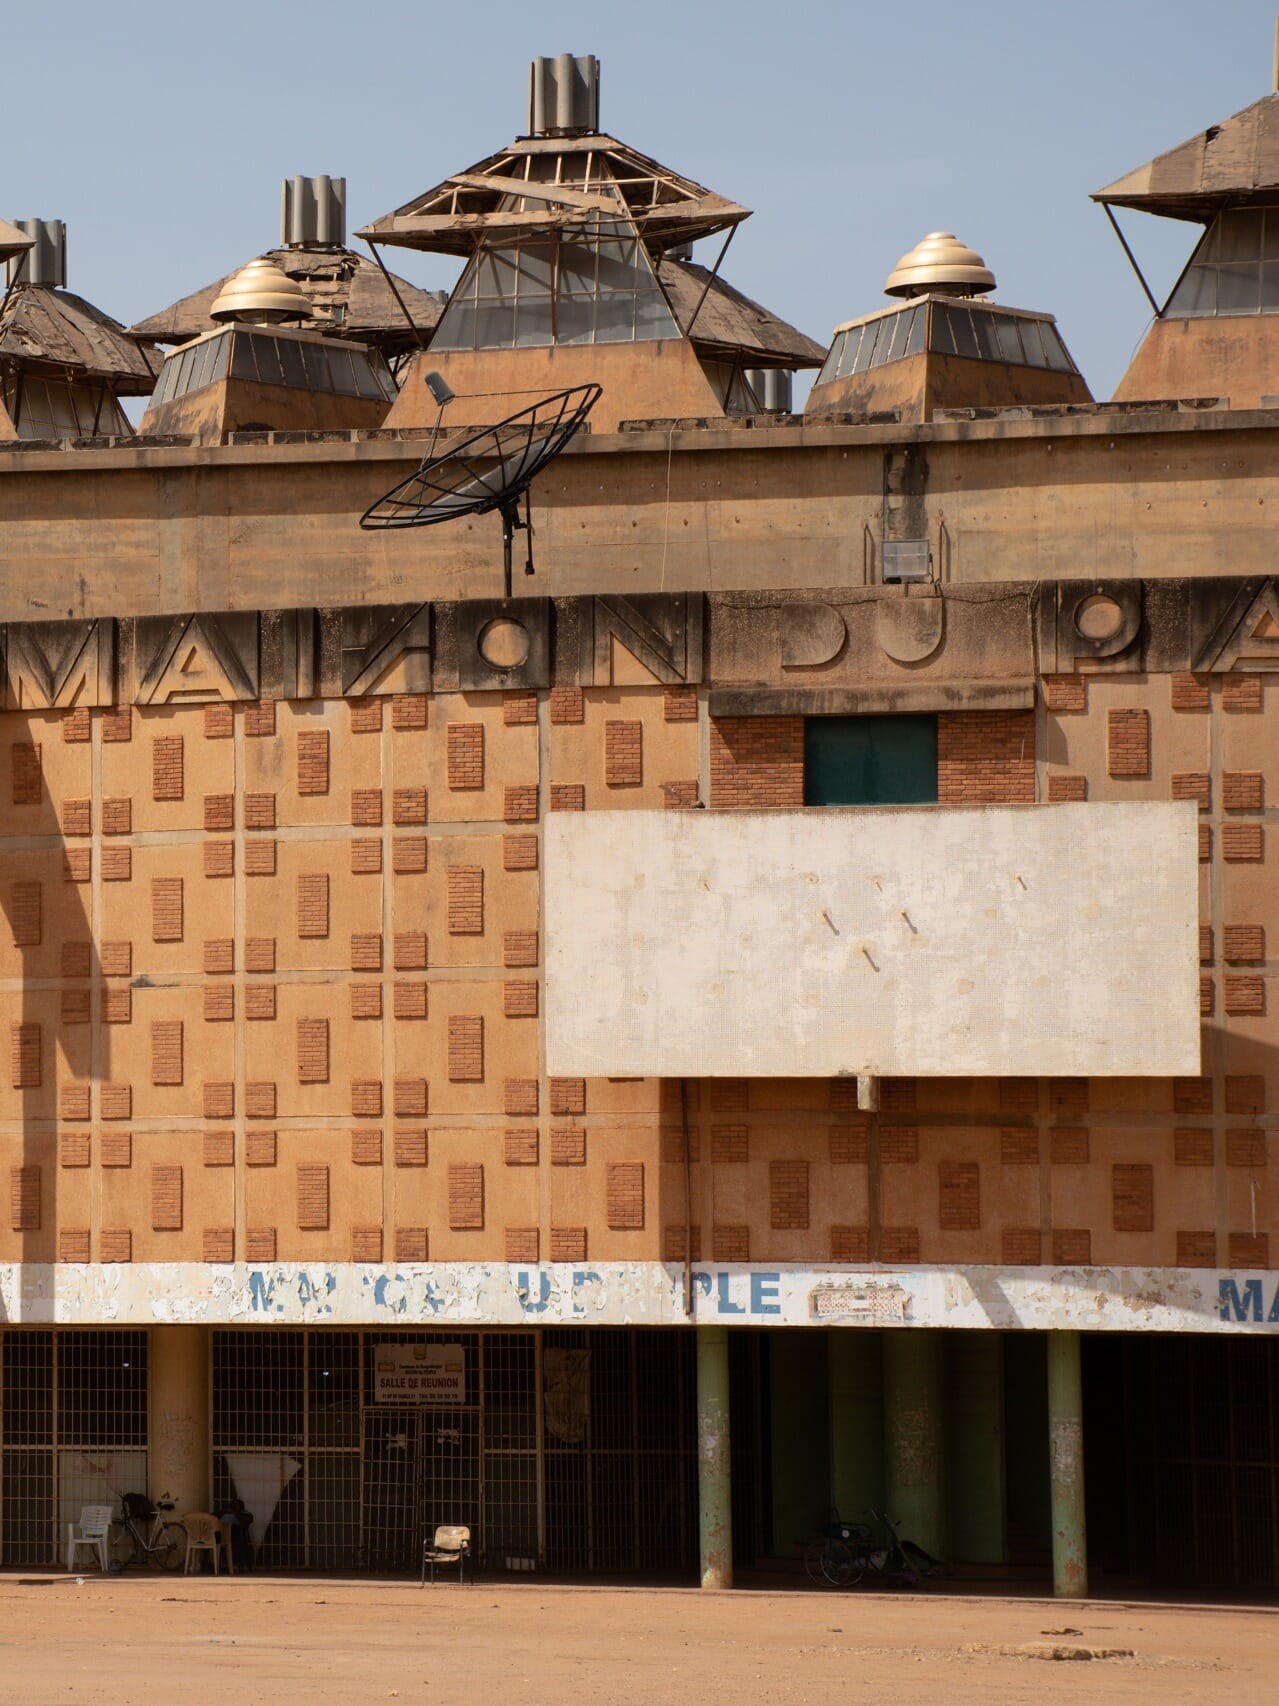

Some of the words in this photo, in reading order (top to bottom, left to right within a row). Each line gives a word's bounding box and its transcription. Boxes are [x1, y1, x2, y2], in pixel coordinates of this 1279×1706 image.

[781, 598, 944, 665] DU
[380, 1377, 406, 1388] SALLE
[408, 1377, 419, 1389] DE
[421, 1377, 459, 1388] REUNION
